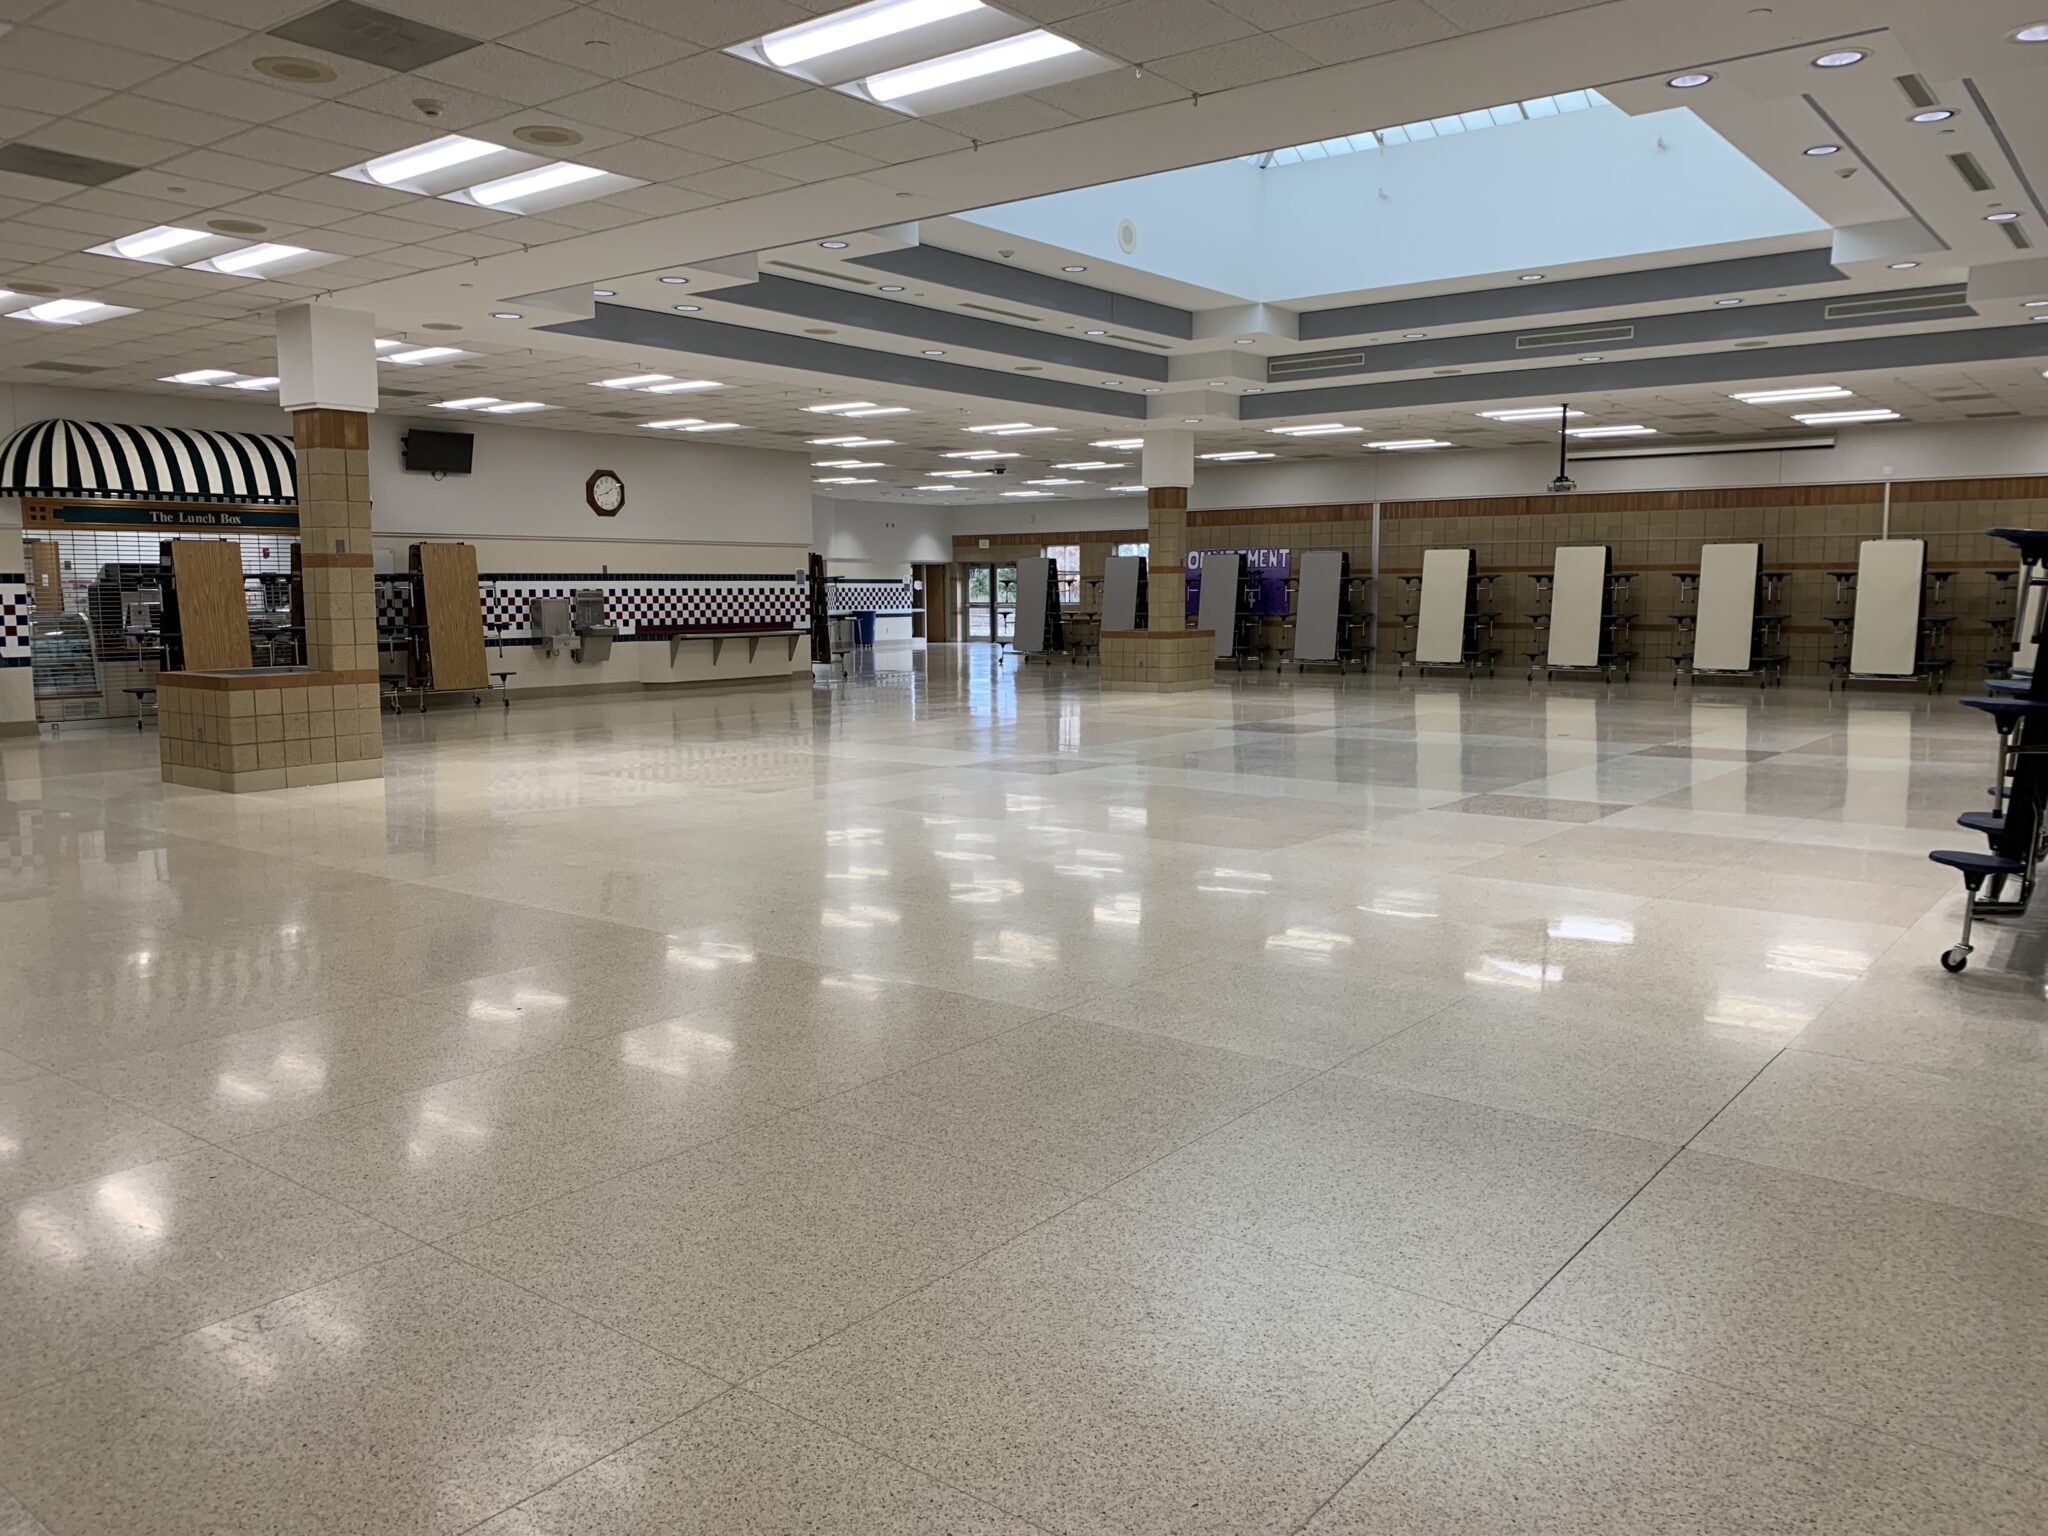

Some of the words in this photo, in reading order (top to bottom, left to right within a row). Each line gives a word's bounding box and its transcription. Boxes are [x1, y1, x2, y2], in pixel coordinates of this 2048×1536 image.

[149, 511, 174, 523] The
[178, 511, 216, 524] Lunch
[220, 512, 242, 525] Box
